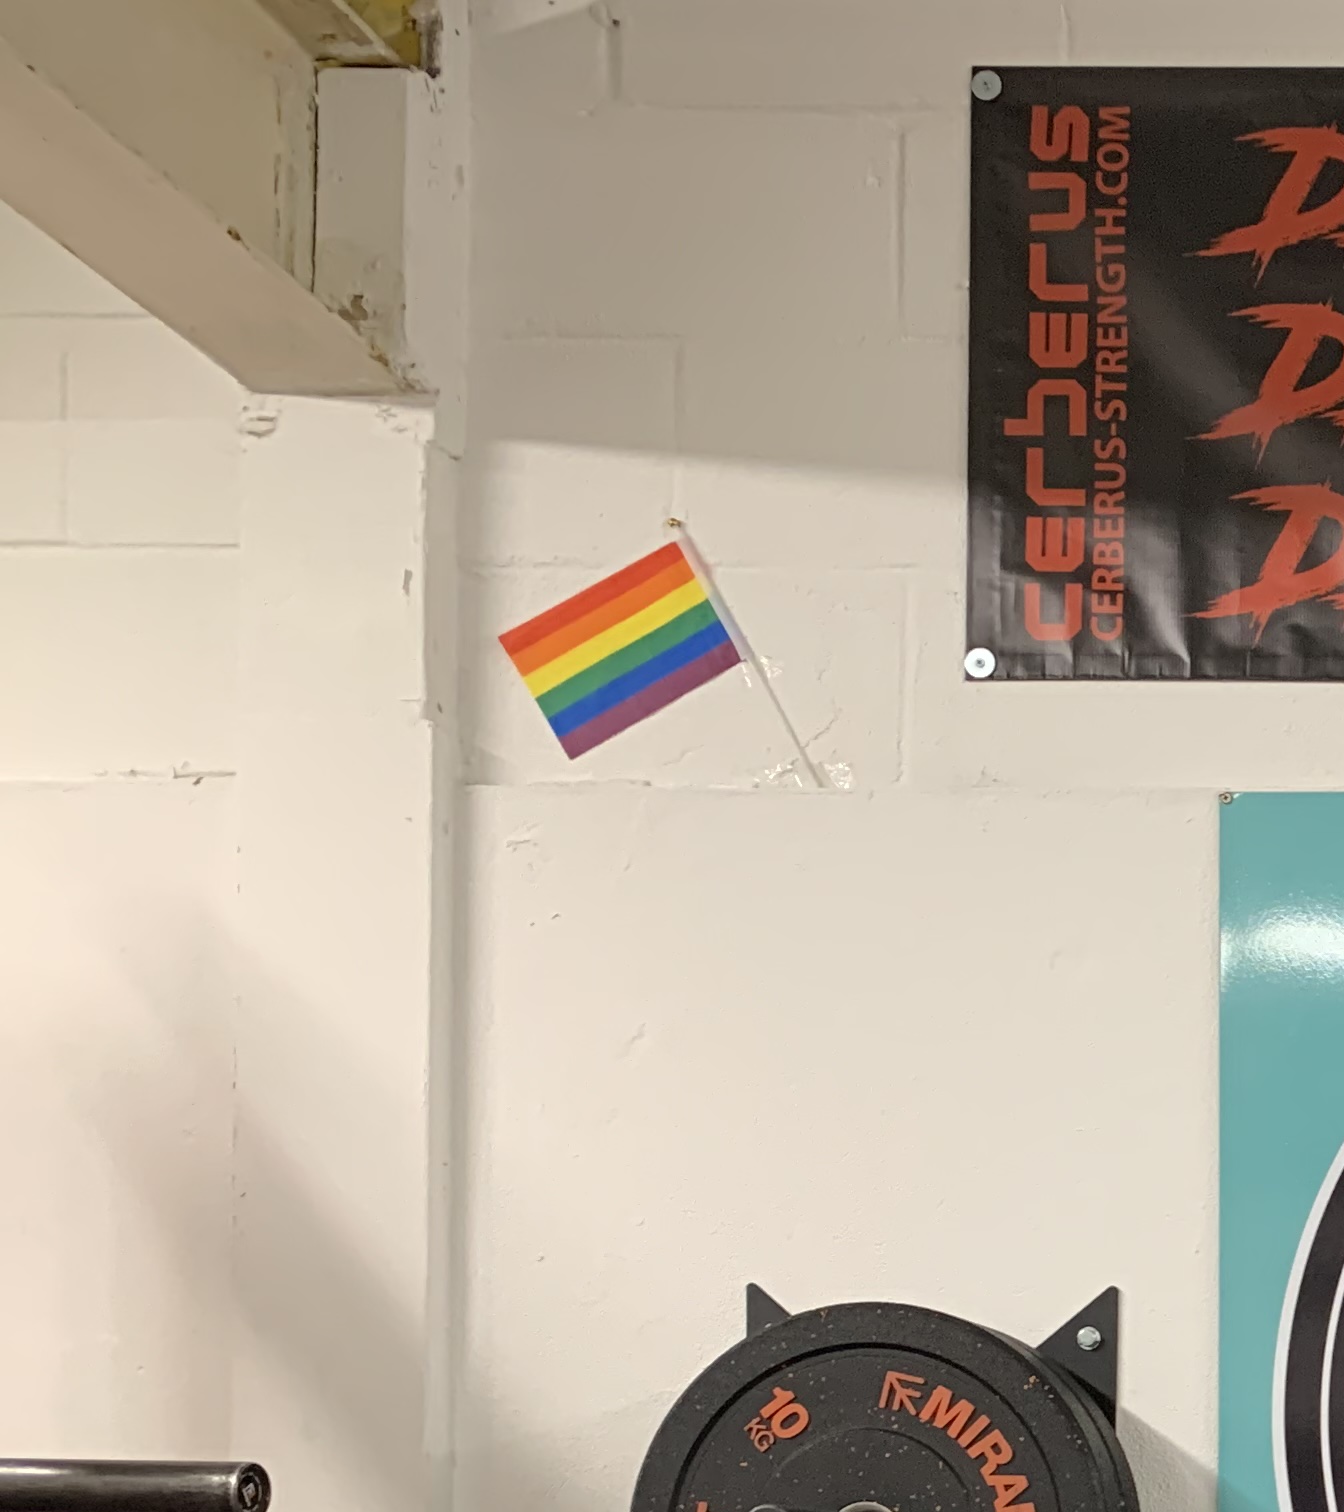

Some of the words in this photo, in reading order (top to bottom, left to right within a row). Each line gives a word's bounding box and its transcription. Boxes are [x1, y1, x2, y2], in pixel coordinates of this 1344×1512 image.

[1090, 106, 1131, 641] CERBERUS-STRENGTH.COM
[743, 1416, 776, 1452] KG
[759, 1387, 810, 1439] 10
